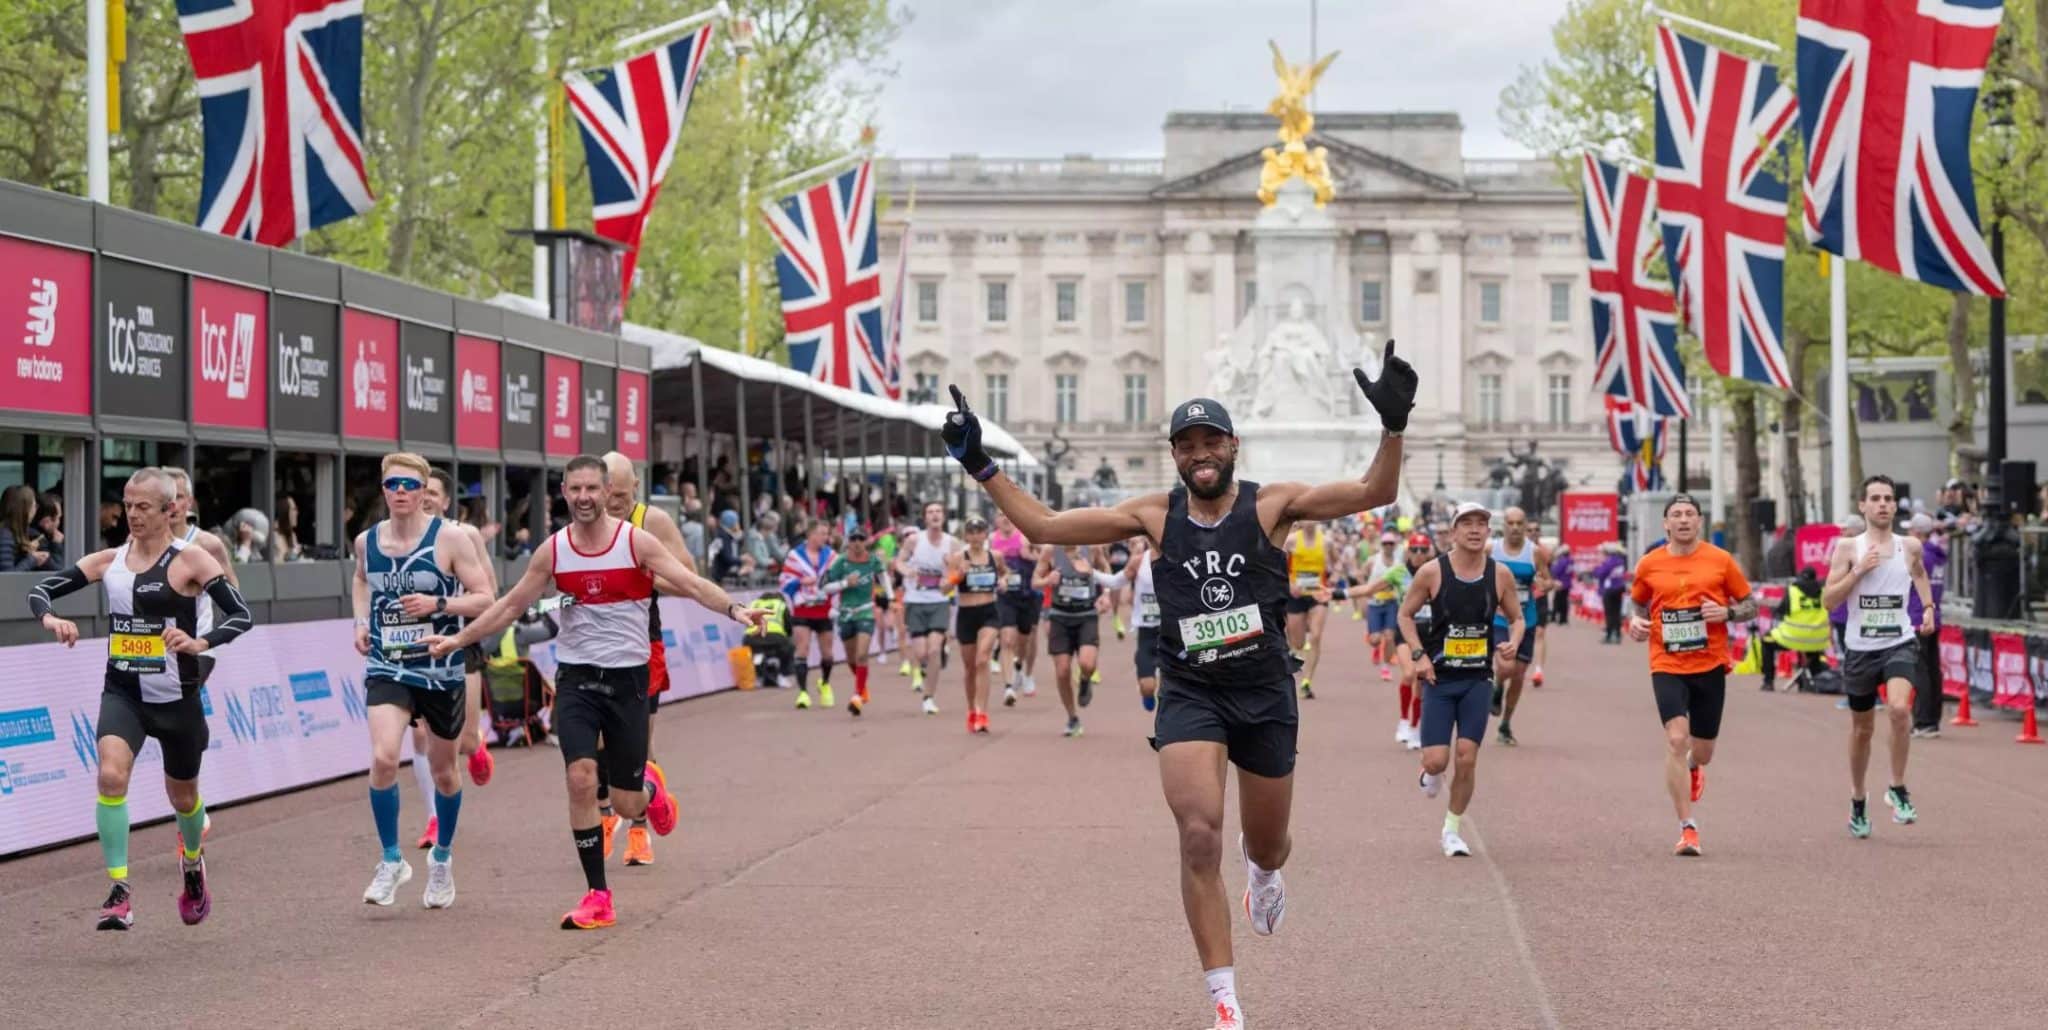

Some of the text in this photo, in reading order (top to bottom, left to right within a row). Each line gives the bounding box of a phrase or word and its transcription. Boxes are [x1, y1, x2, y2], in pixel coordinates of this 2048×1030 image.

[109, 301, 135, 374] tcs
[202, 307, 227, 382] tcs
[17, 353, 62, 382] new balance
[280, 332, 299, 395] tcs
[407, 354, 423, 410] tcs
[383, 572, 415, 591] DOUG
[1862, 596, 1878, 608] tcs
[383, 611, 399, 624] tcs
[1662, 609, 1678, 622] tcs
[114, 617, 130, 632] tcs
[1193, 613, 1249, 640] 39103
[1668, 625, 1700, 638] 39013
[390, 629, 425, 642] 44027
[122, 640, 152, 655] 5498
